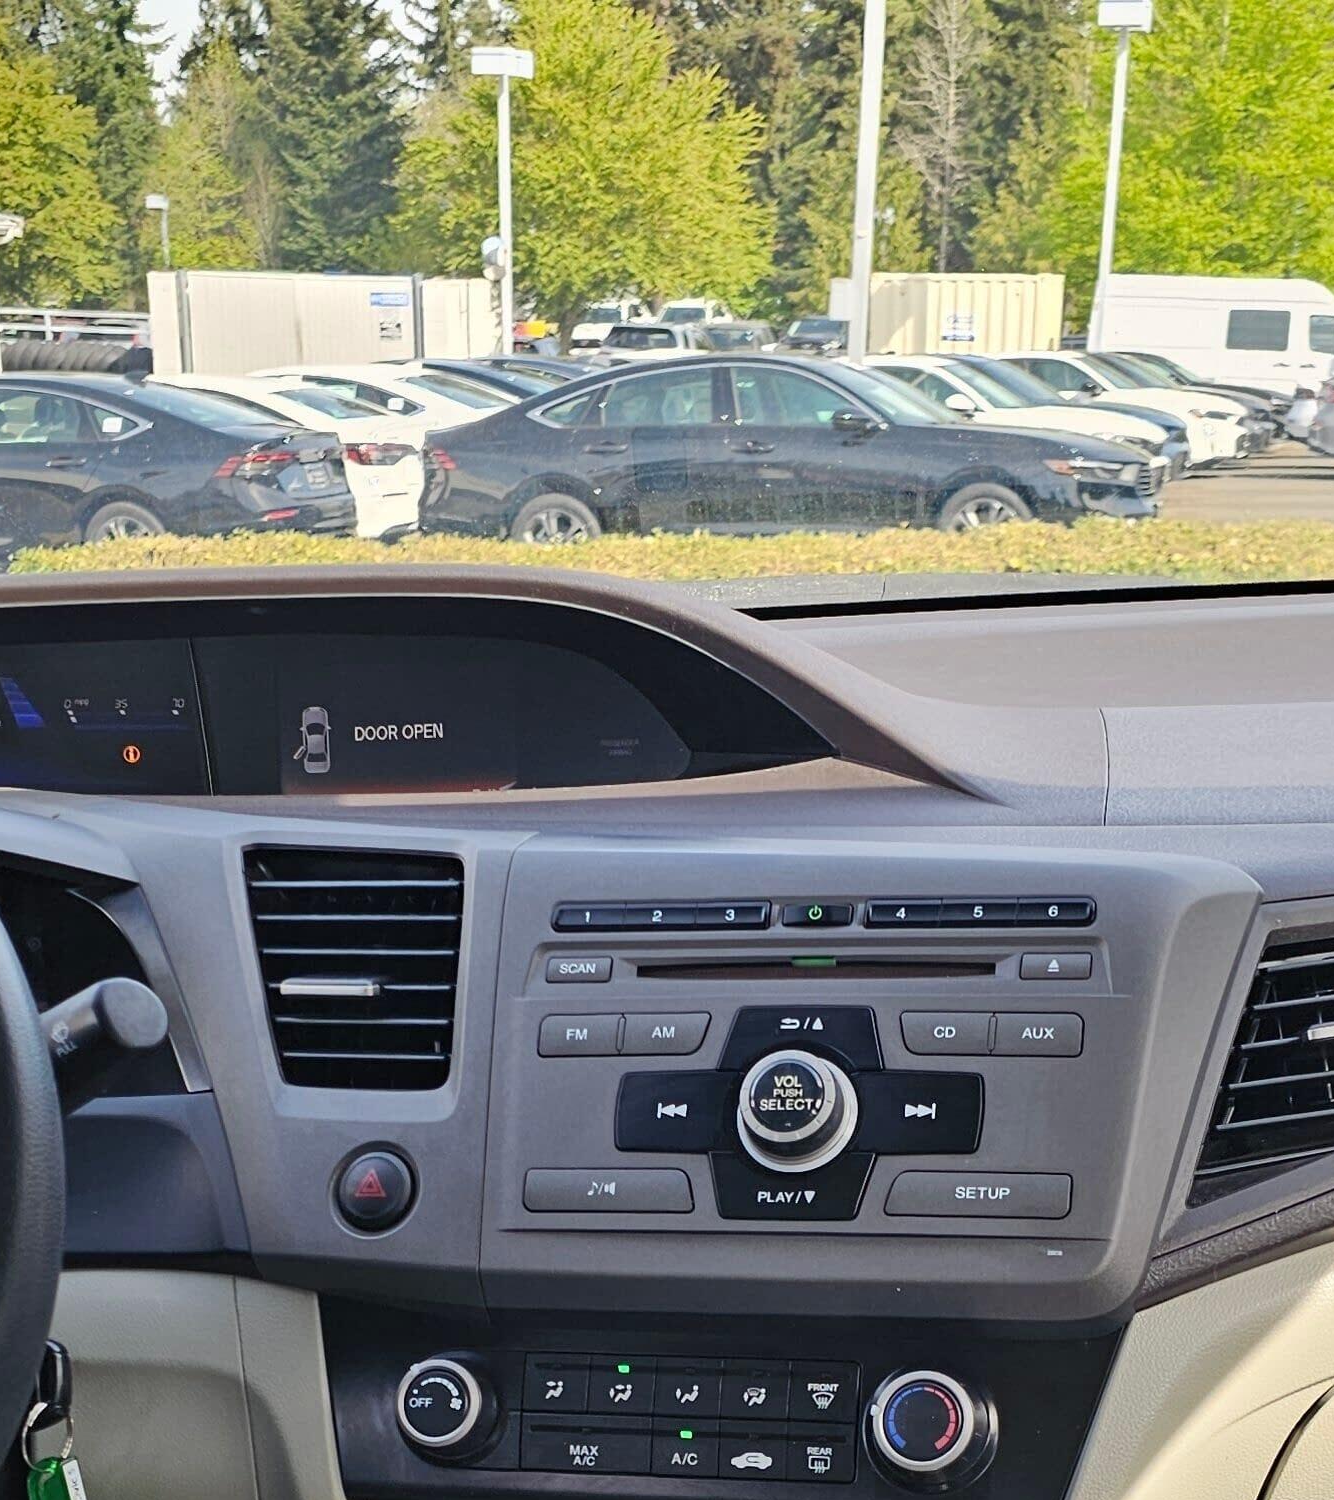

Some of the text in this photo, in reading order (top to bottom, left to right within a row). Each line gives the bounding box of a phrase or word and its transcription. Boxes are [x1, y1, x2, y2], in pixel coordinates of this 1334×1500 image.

[63, 699, 72, 709] 0
[114, 698, 128, 709] 35
[354, 722, 444, 741] DOOR OPEN
[584, 911, 592, 923] 1
[651, 910, 663, 923] 2
[724, 909, 736, 921] 3
[896, 906, 907, 920] 4
[973, 906, 984, 918] 5
[1047, 905, 1059, 918] 6
[558, 962, 597, 974] SCAN
[566, 1028, 588, 1040] FM
[651, 1026, 675, 1038] AM
[933, 1026, 956, 1039] CD
[1021, 1027, 1055, 1040] AUX
[773, 1075, 802, 1088] VOL
[773, 1088, 803, 1098] PUSH
[759, 1098, 815, 1111] SELECT
[954, 1186, 1010, 1200] SETUP
[807, 1382, 840, 1392] FRONT
[408, 1397, 434, 1408] OFF
[569, 1445, 599, 1456] MAX
[806, 1446, 833, 1455] REAR
[572, 1455, 596, 1467] A/C
[671, 1452, 699, 1466] A/C
